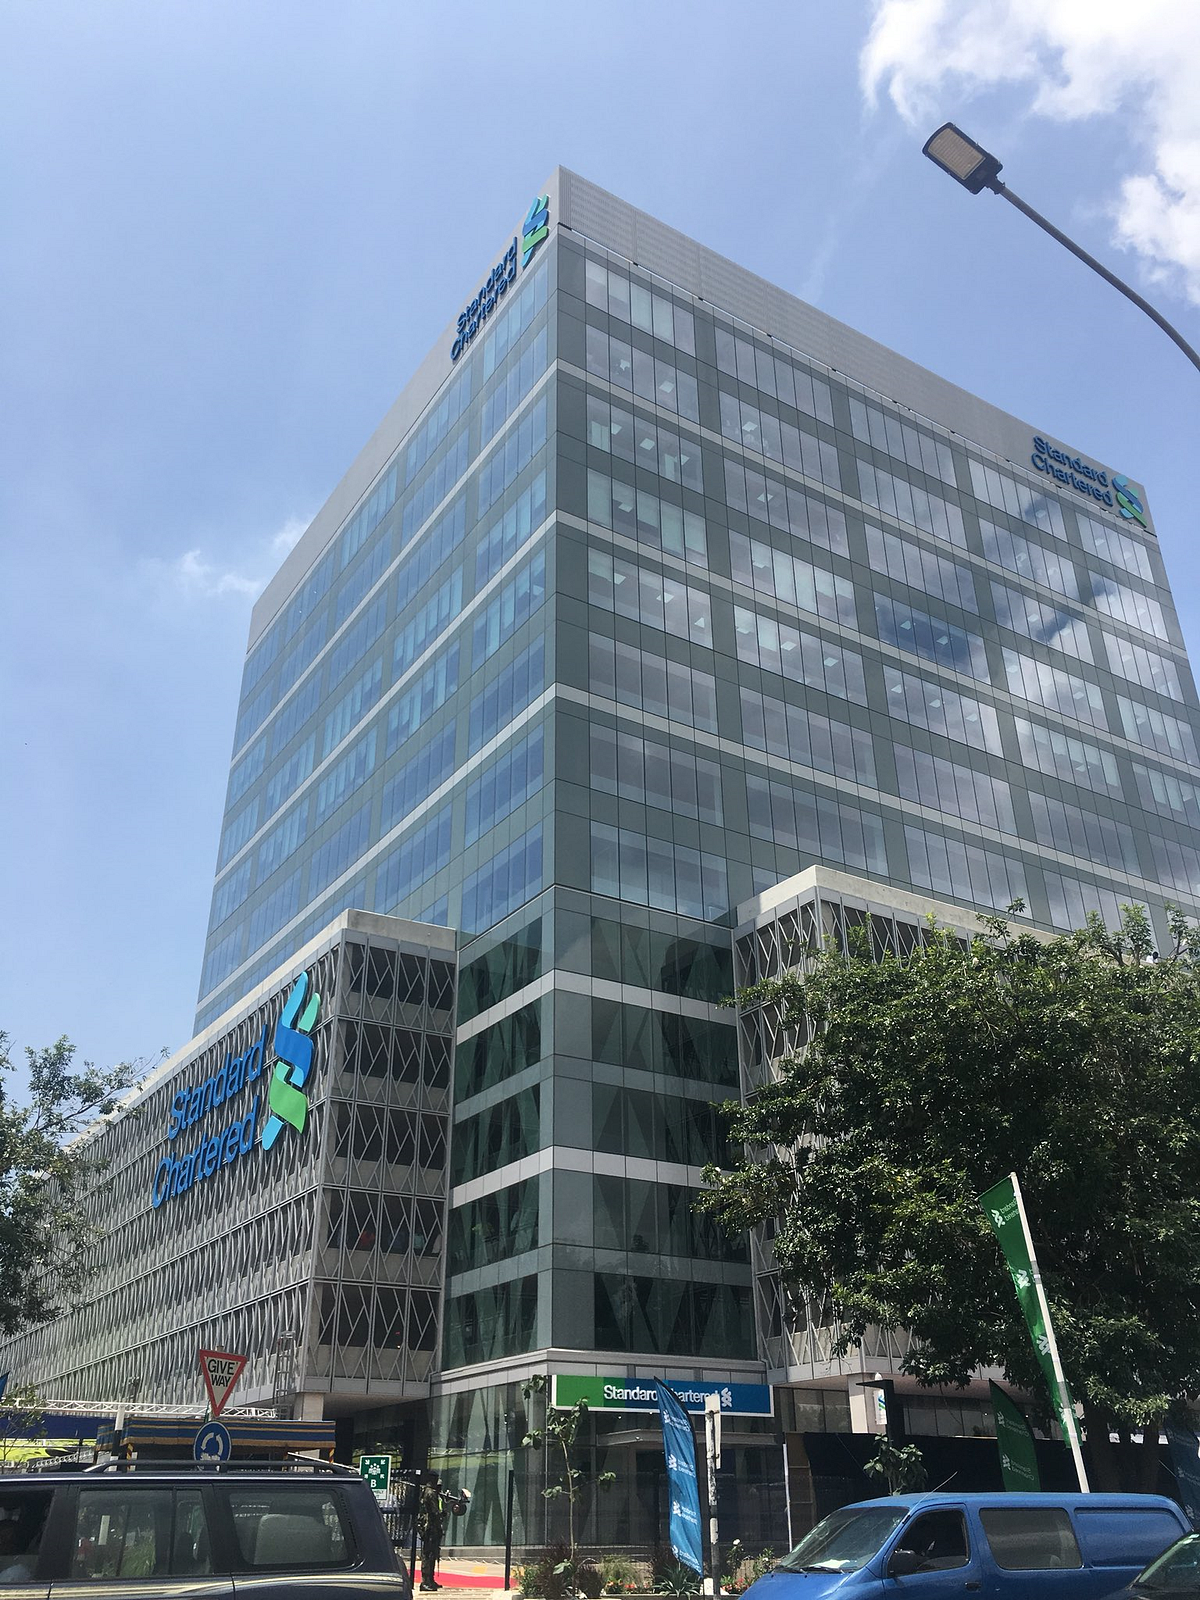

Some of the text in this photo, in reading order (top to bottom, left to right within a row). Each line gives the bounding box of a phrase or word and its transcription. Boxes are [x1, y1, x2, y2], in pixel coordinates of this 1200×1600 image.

[450, 258, 516, 360] Chartered
[457, 237, 517, 333] Standard
[1031, 453, 1113, 507] Chartered
[1033, 436, 1108, 487] Standard
[169, 1024, 267, 1140] Standard
[152, 1095, 259, 1208] Chartered
[207, 1359, 235, 1376] GIVE
[211, 1374, 230, 1387] WAY
[371, 1479, 377, 1488] B
